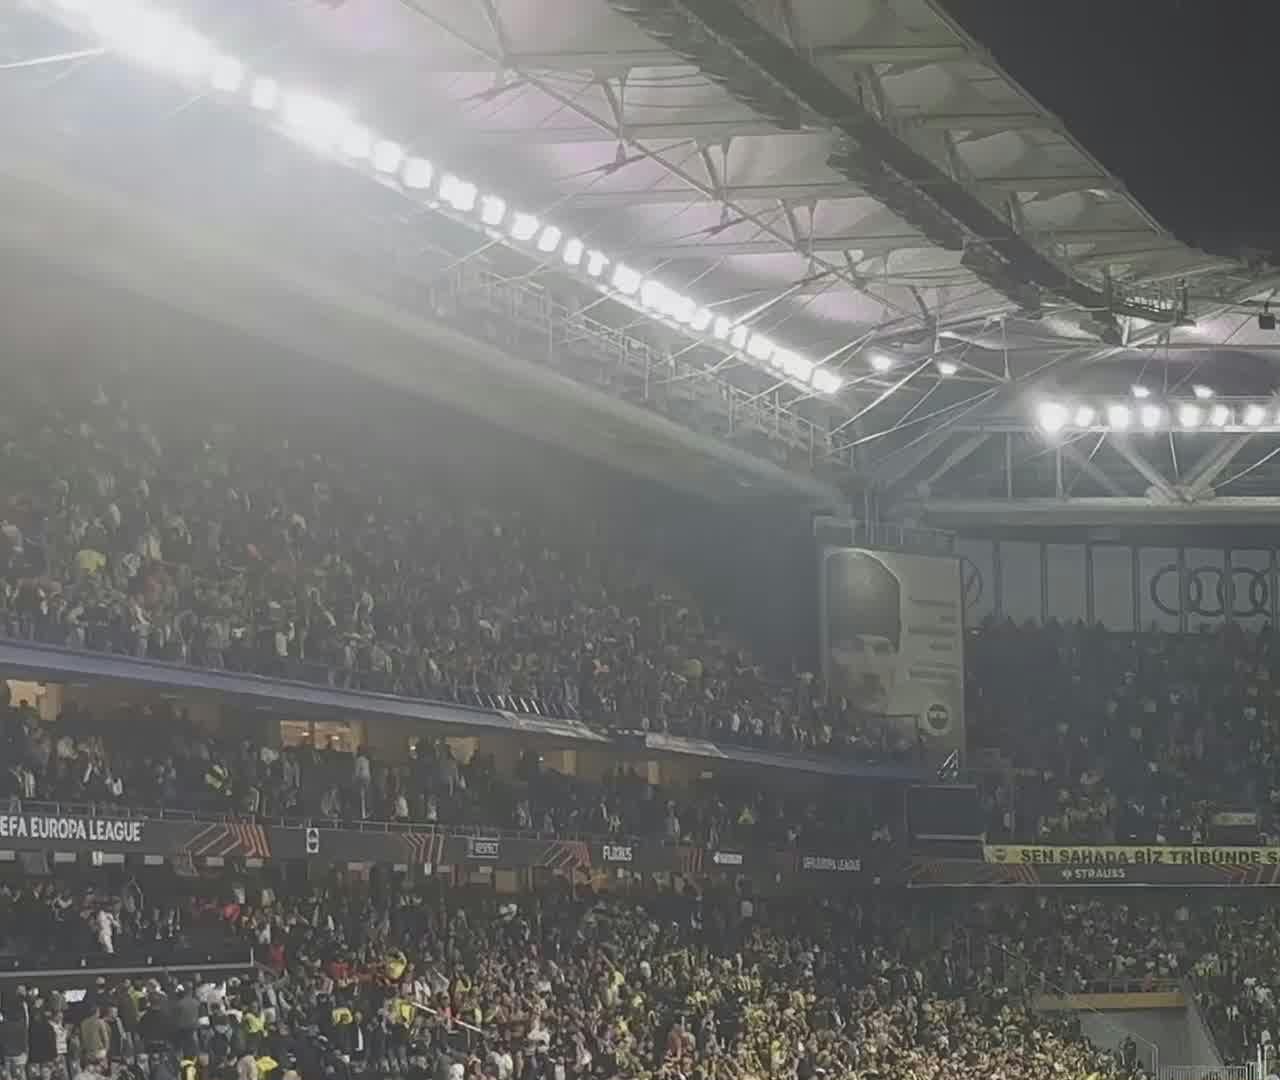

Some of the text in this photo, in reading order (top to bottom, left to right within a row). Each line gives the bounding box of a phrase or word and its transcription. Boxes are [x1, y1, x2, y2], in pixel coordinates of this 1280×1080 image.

[0, 815, 142, 842] EFA EUROPA LEAGUE
[1021, 849, 1054, 863] SEN
